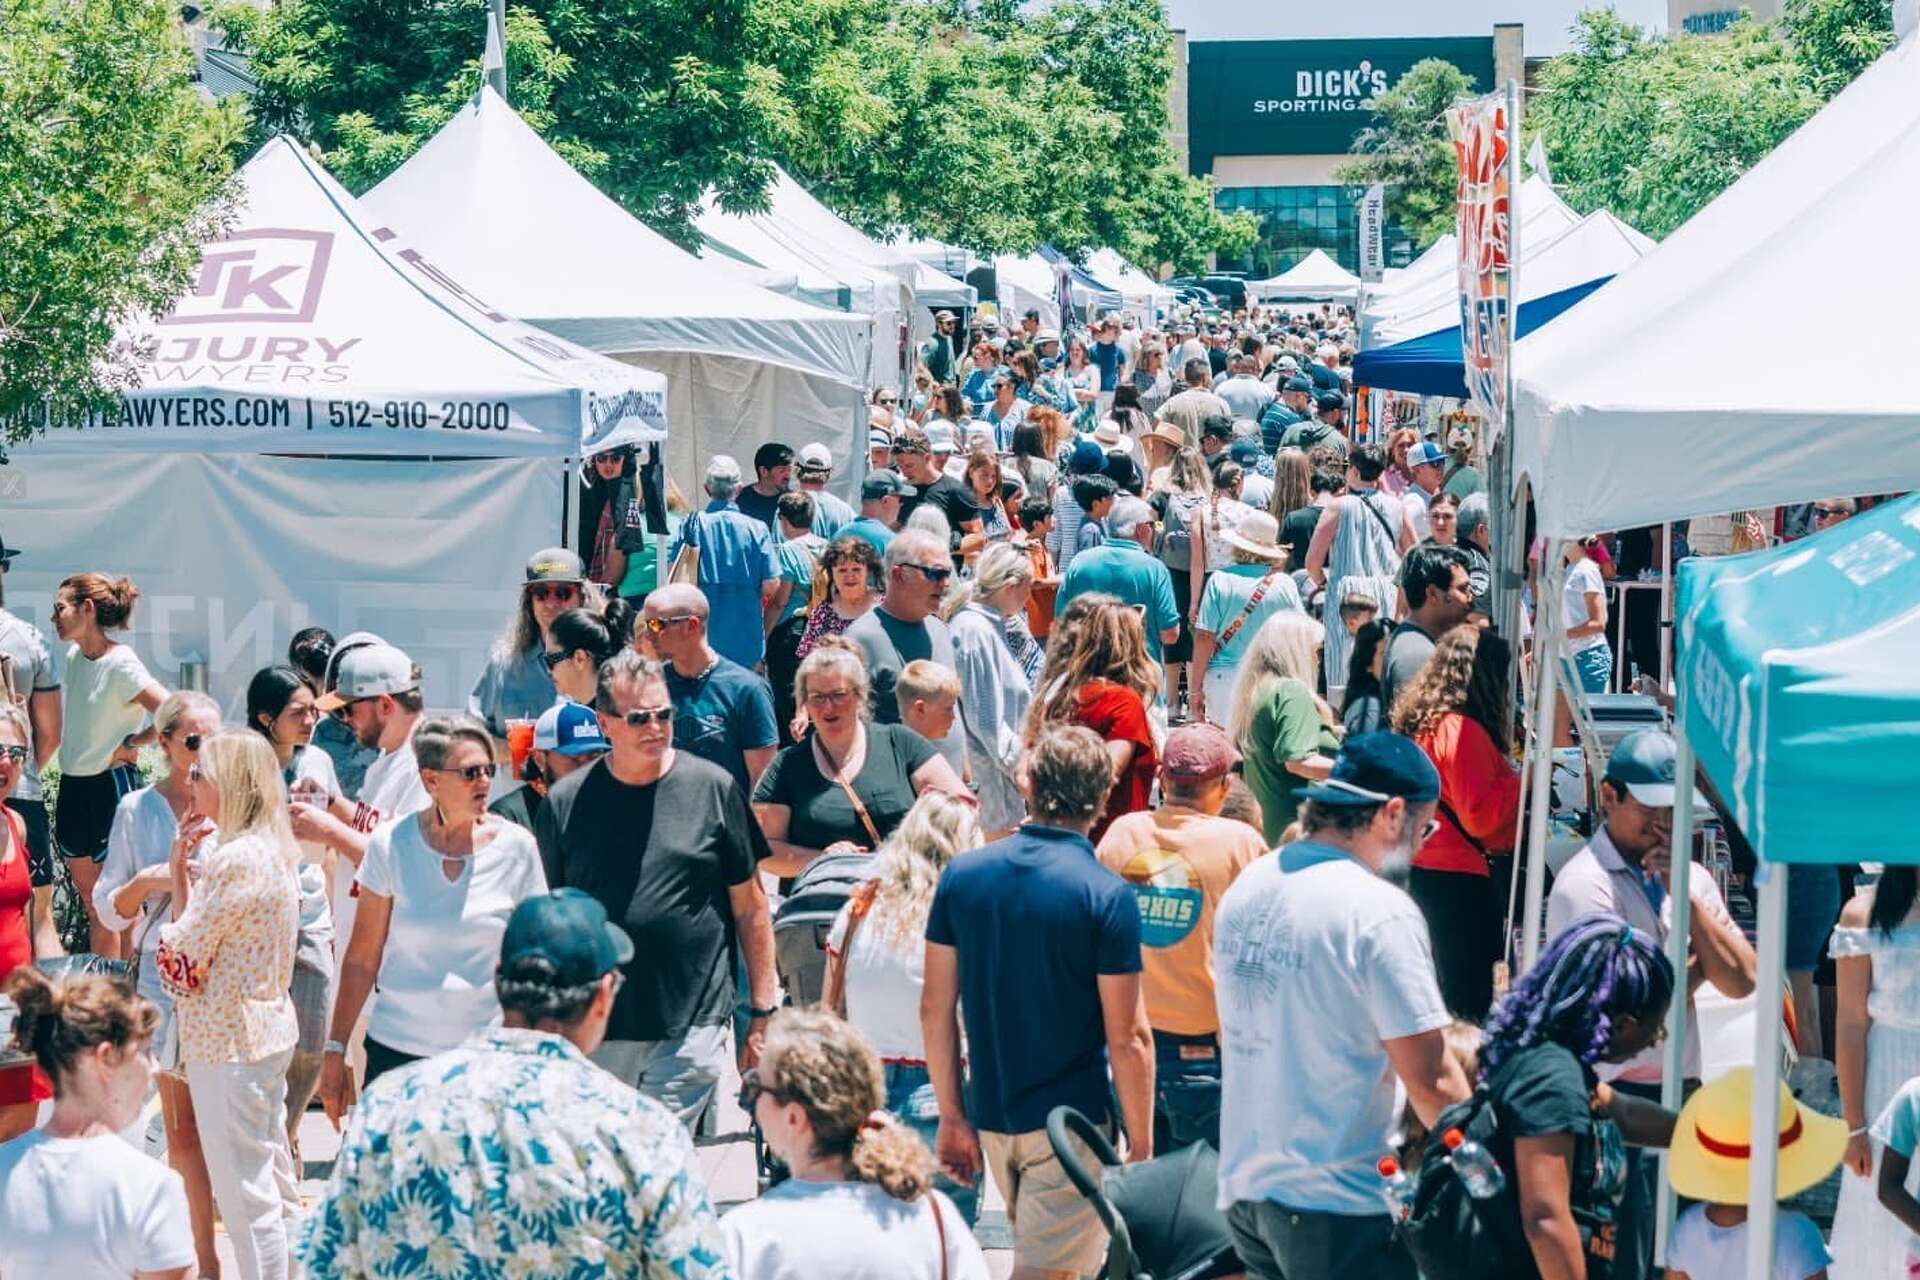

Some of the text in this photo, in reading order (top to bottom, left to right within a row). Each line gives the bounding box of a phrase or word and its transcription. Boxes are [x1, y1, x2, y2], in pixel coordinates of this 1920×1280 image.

[1296, 61, 1387, 97] DICK'S
[1253, 99, 1357, 112] SPORTING
[112, 336, 362, 363] NJURY
[141, 364, 349, 383] WYERS
[328, 399, 510, 431] 512-910-2000
